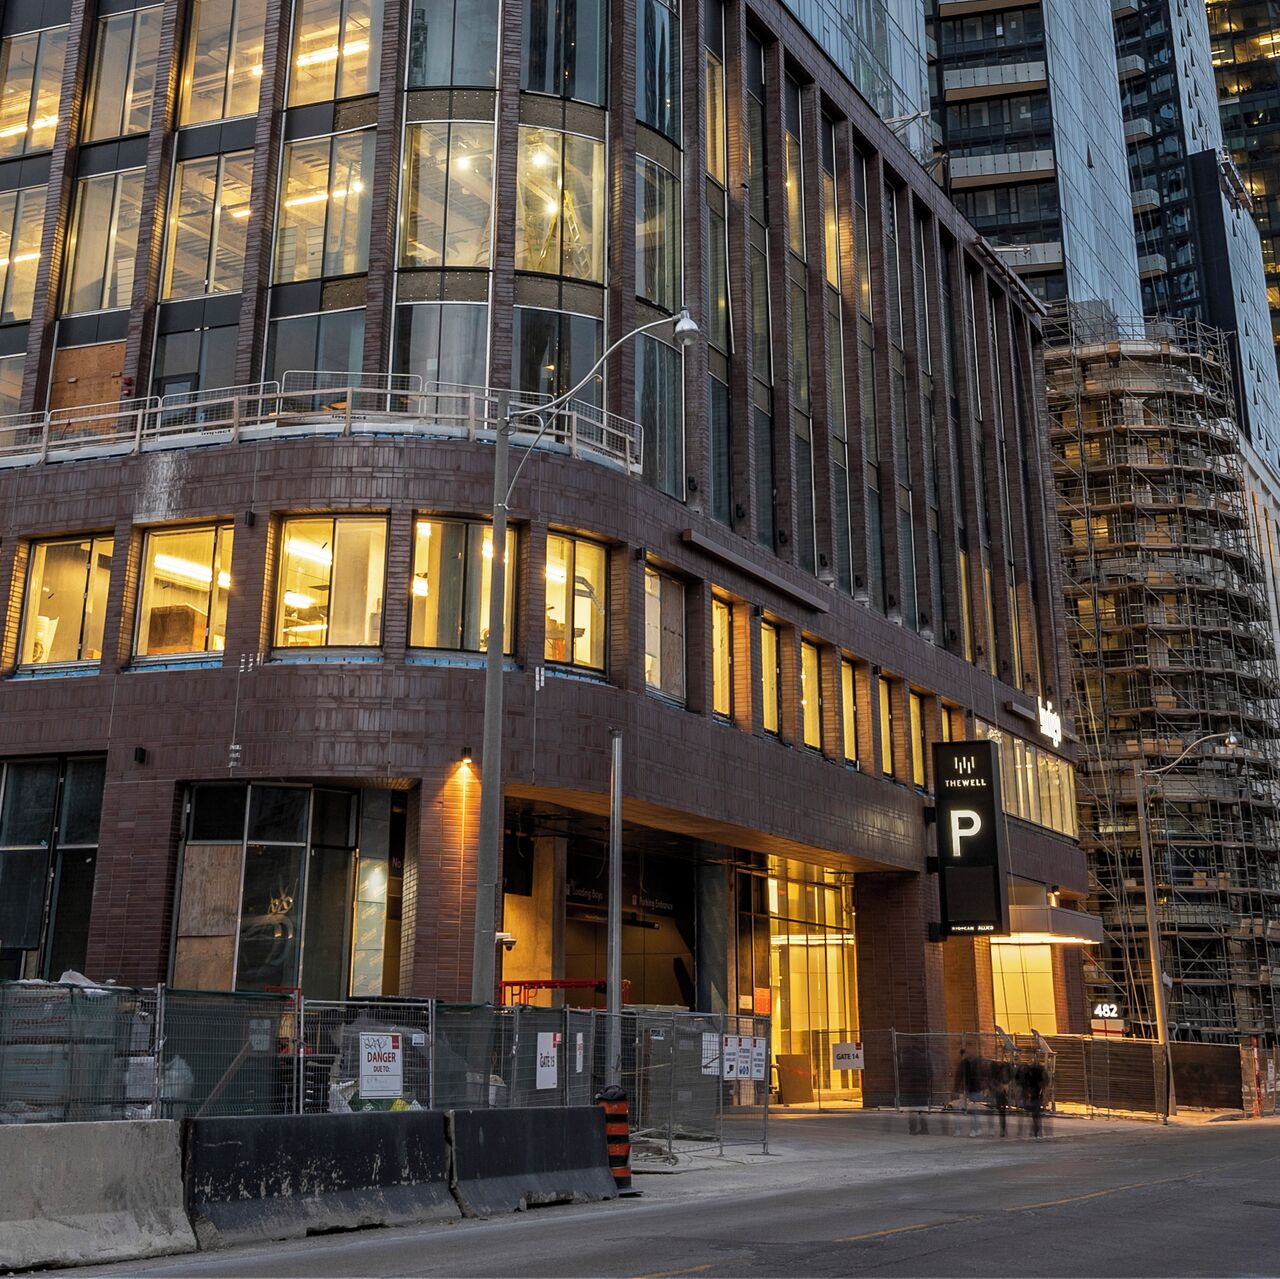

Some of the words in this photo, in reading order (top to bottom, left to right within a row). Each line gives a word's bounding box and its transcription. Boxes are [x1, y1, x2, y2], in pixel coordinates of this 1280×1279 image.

[950, 809, 982, 857] P
[1094, 1004, 1118, 1017] 482
[367, 1051, 396, 1062] DANGER
